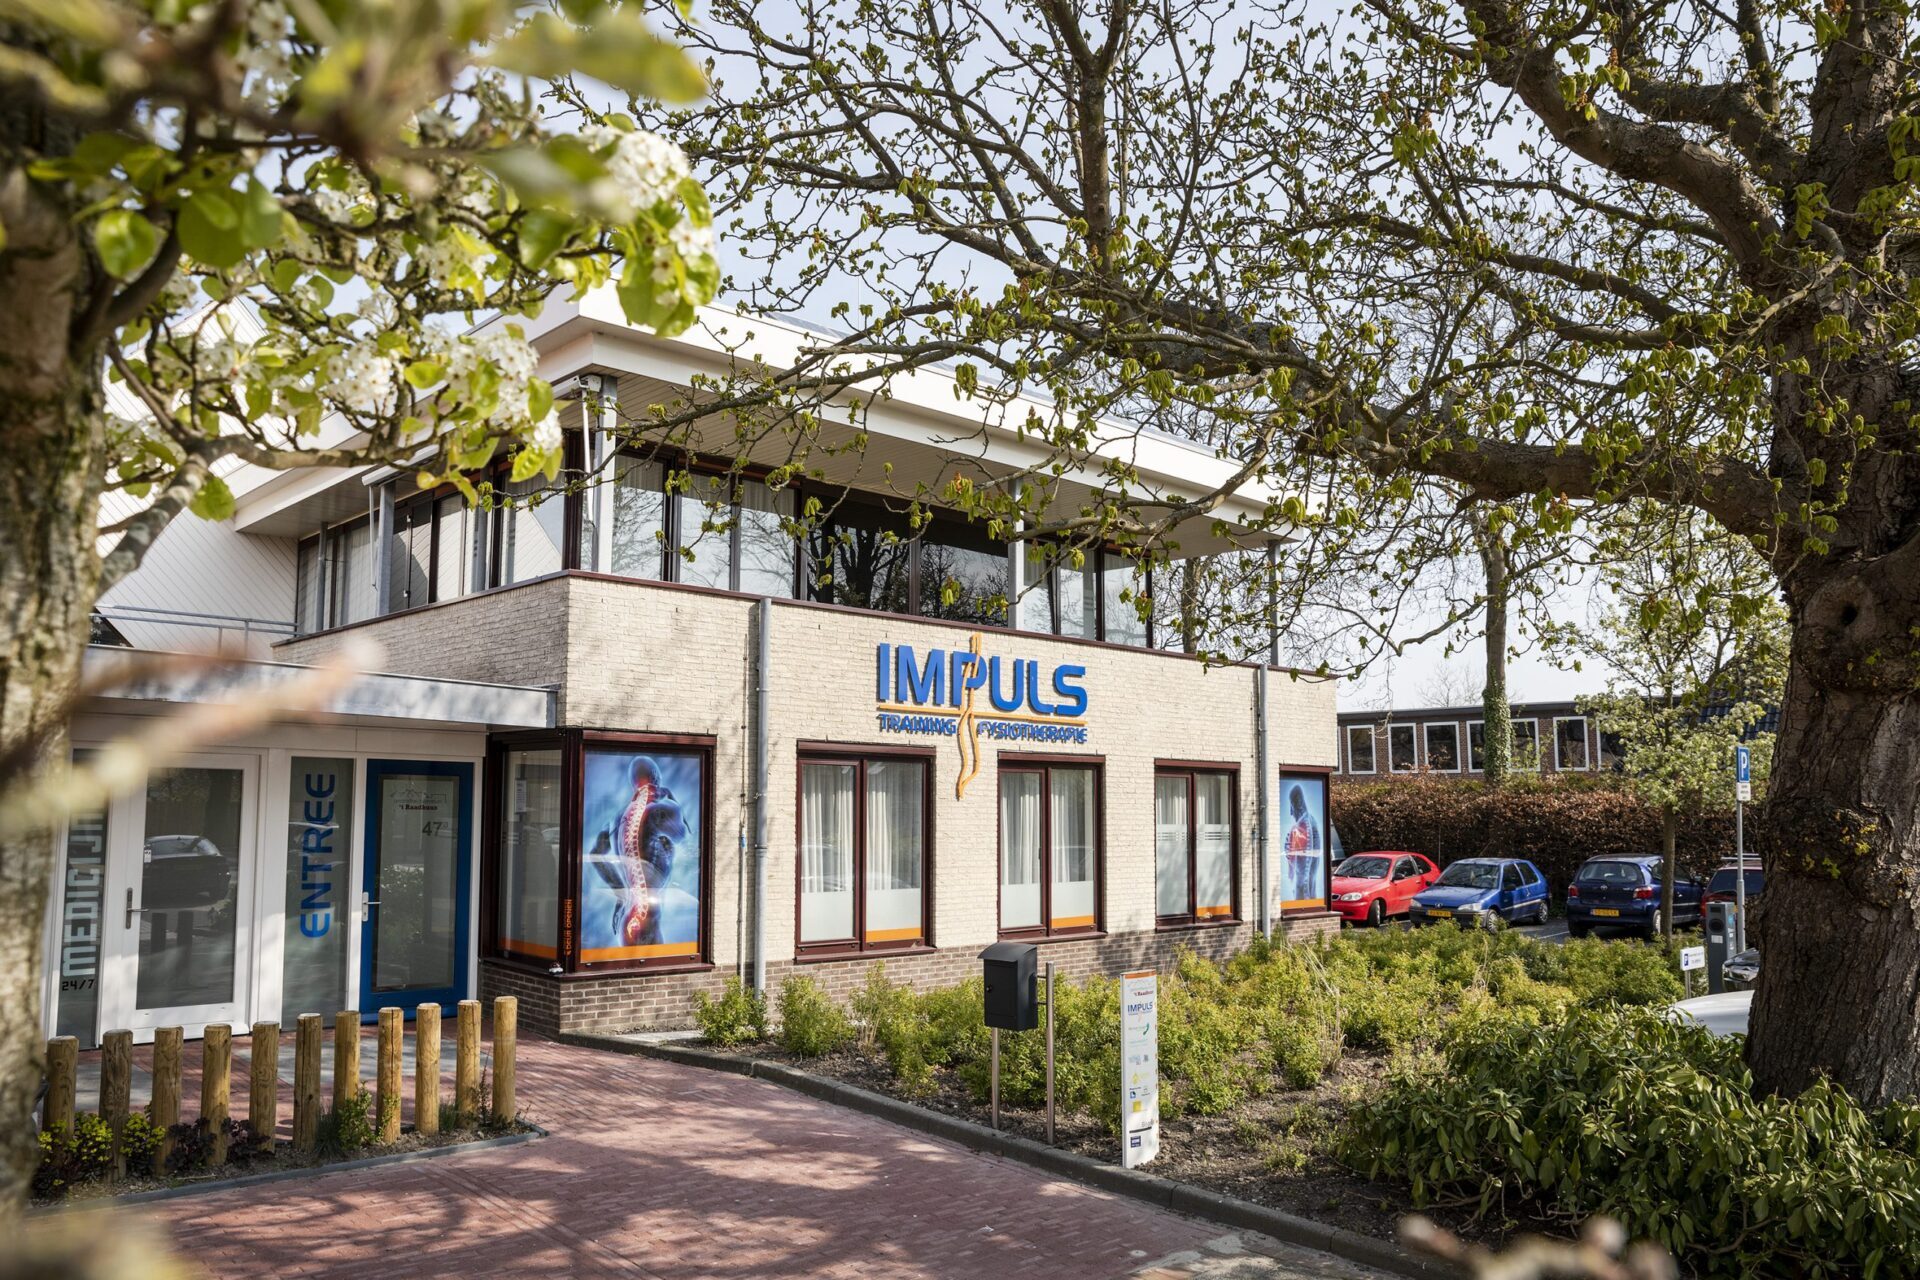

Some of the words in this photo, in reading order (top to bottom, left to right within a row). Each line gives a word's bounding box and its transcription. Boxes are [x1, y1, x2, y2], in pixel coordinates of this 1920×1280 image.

[880, 643, 1087, 717] IMPULS
[879, 714, 957, 735] TRAINING
[977, 720, 1088, 743] FYSIOTHERAPIE
[1740, 751, 1748, 778] P
[300, 774, 336, 938] ENTREE
[62, 979, 94, 991] 24/7
[1127, 1002, 1153, 1012] IMPULS
